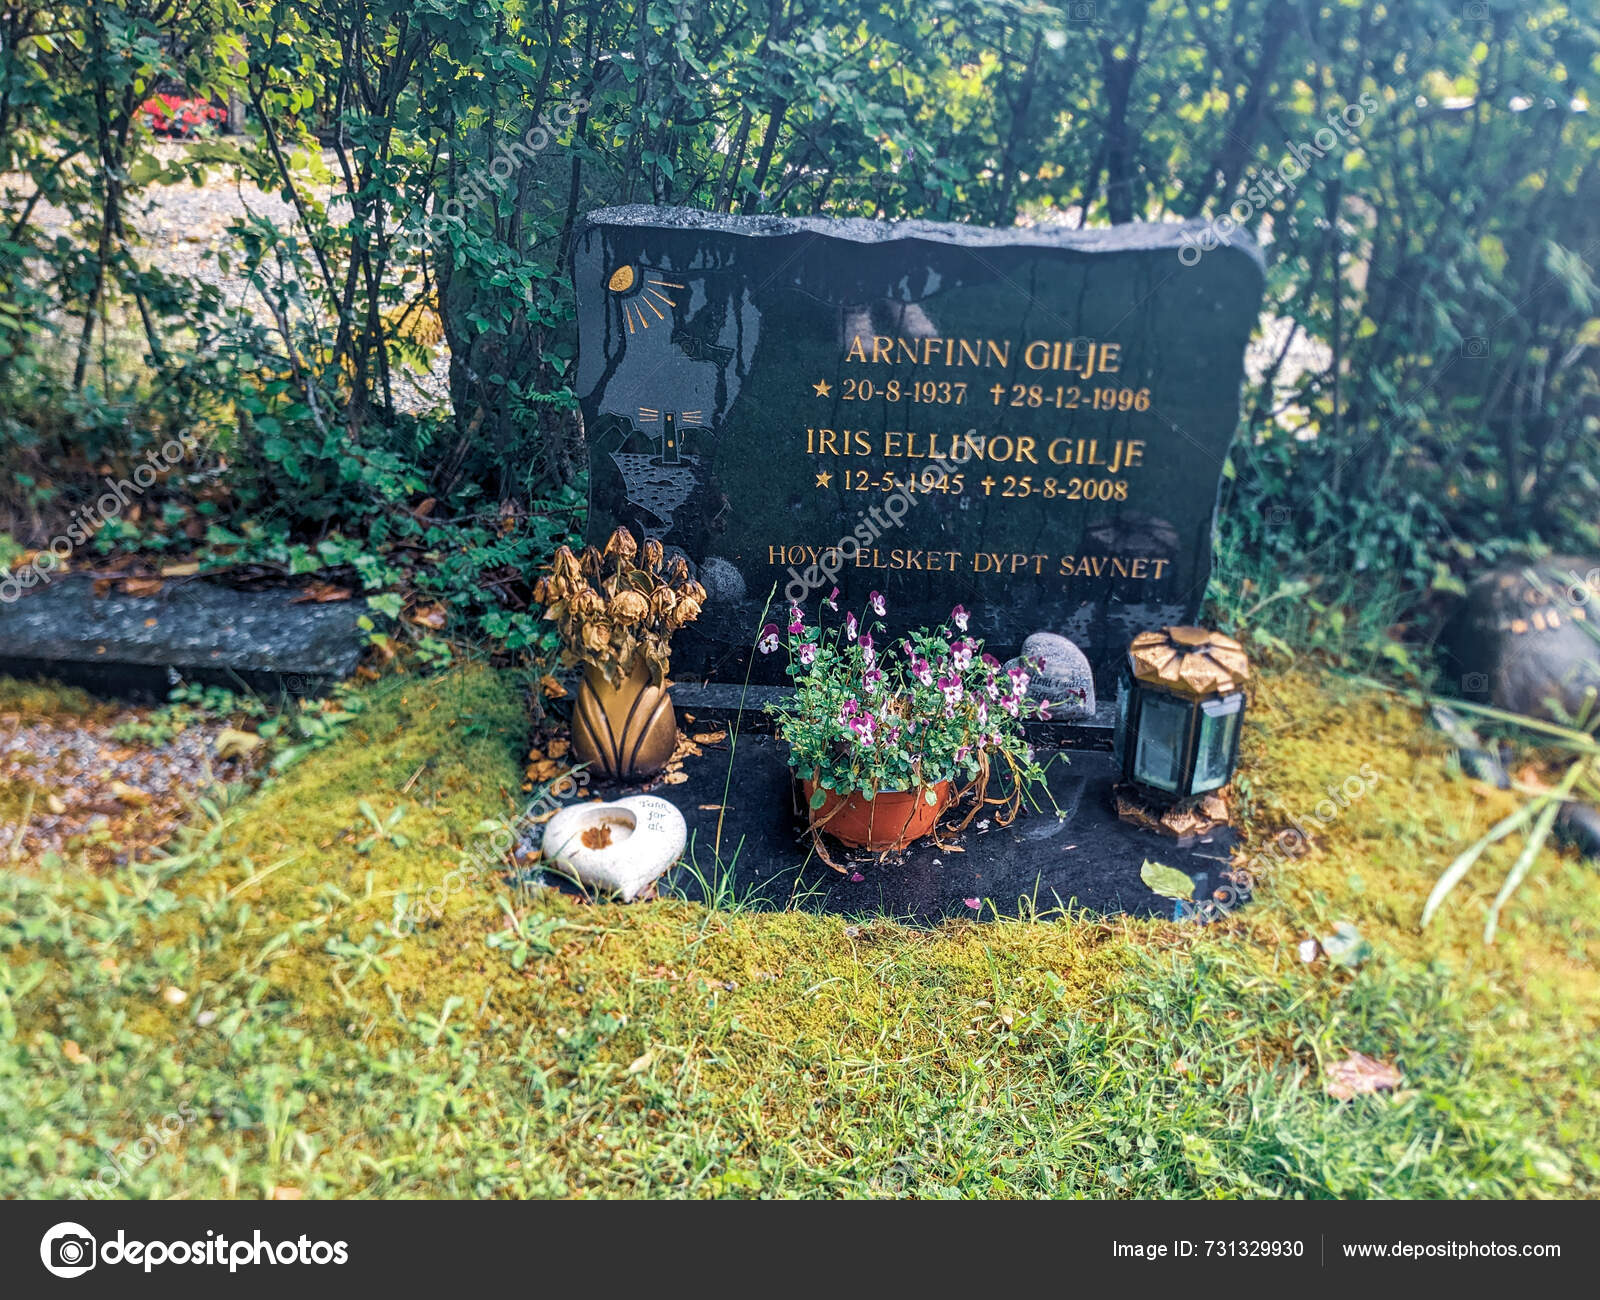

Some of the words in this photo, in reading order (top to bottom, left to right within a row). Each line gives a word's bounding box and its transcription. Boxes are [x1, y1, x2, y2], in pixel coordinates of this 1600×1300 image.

[846, 335, 1010, 368] ARNFINN
[1024, 340, 1121, 379] GILJE
[842, 379, 968, 405] 20-8-1937
[1010, 384, 1151, 412] 28-12-1996
[805, 428, 872, 457] IRIS
[884, 431, 1039, 465] ELLINOR
[1048, 438, 1146, 473] GILJE
[844, 470, 965, 496] 12-5-1945
[1001, 476, 1129, 501] 25-8-2008
[768, 545, 843, 568] HØYT
[855, 548, 961, 572] ELSKET
[974, 553, 1049, 576] DYPT
[1059, 556, 1170, 580] SAVNET
